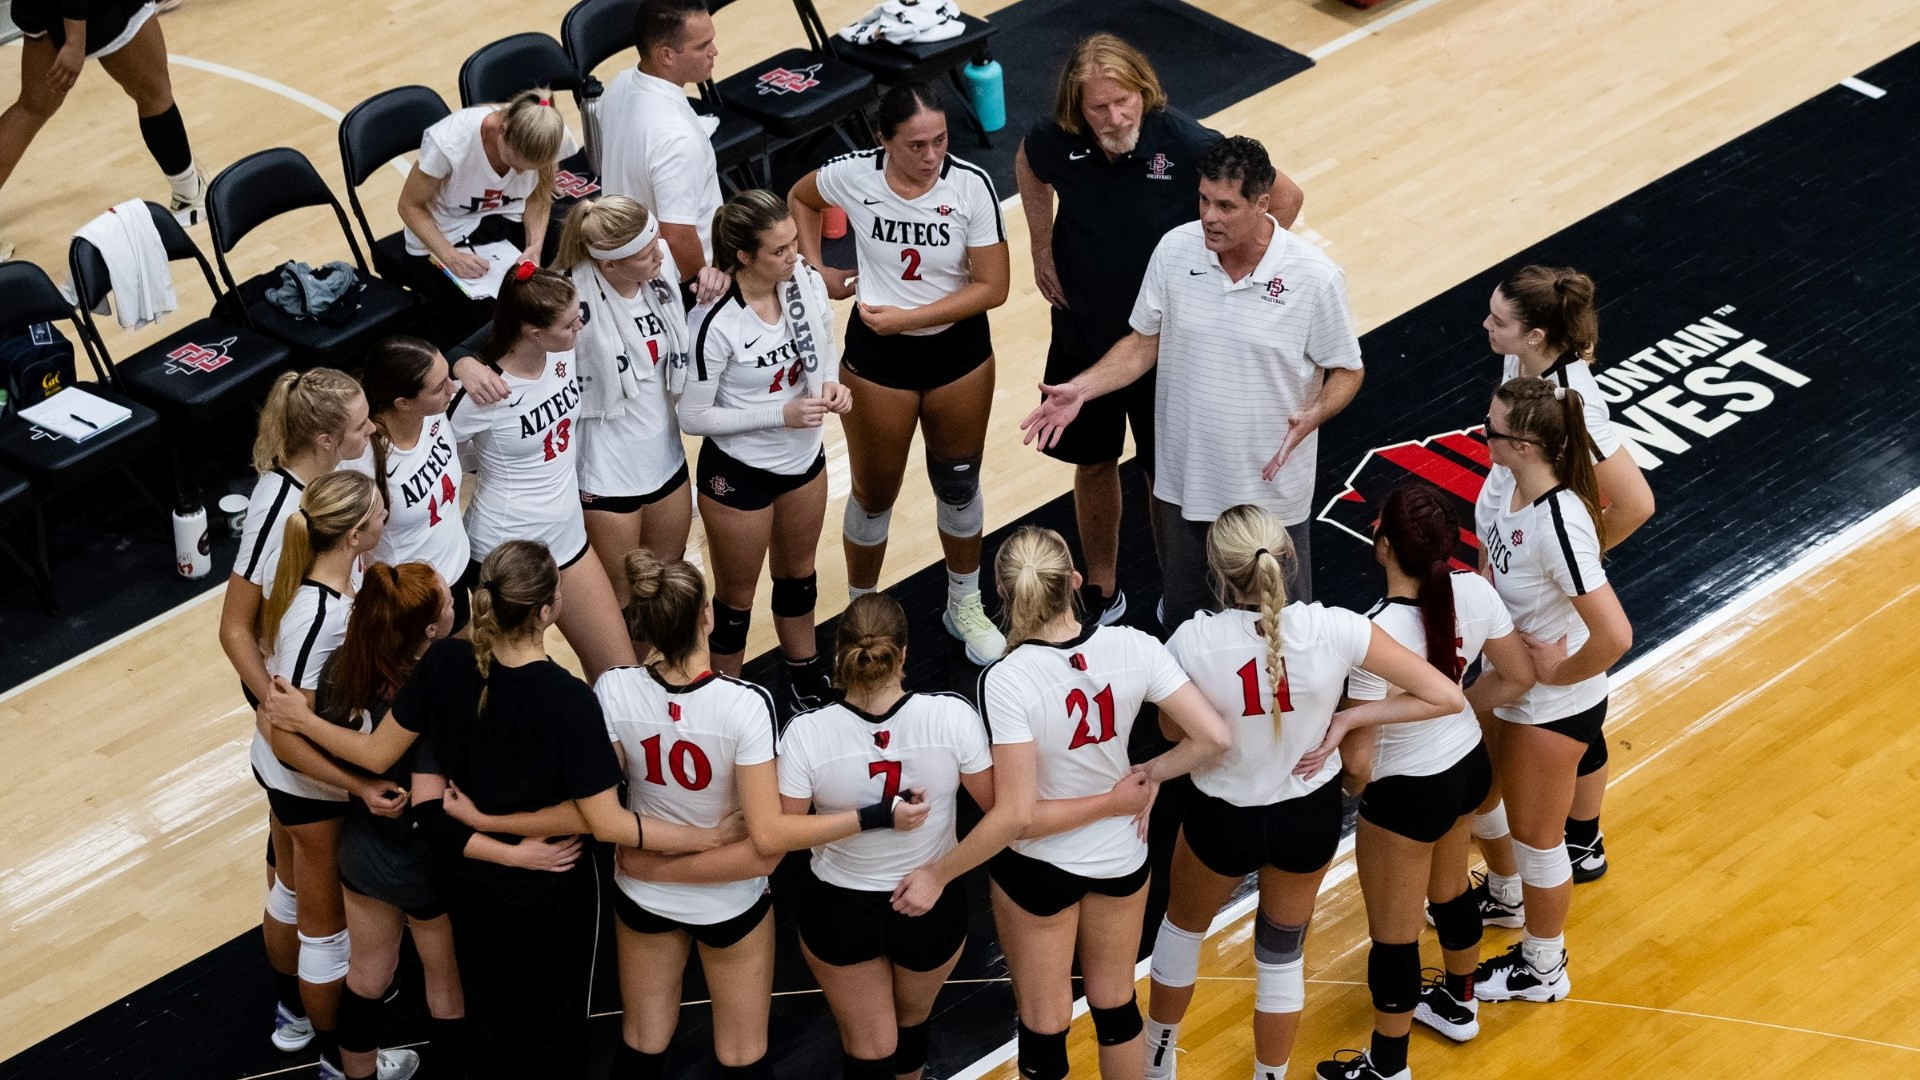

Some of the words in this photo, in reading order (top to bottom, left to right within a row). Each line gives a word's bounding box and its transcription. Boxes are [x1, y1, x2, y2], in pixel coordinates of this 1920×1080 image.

[871, 216, 951, 247] AZTECS
[901, 248, 922, 281] 2
[786, 275, 818, 373] GATOR
[42, 370, 60, 389] Cal
[1594, 316, 1744, 404] UNTAIN
[519, 379, 580, 440] AZTECS
[542, 418, 572, 462] 13
[400, 435, 452, 509] AZTECS
[427, 473, 456, 528] 14
[1065, 682, 1118, 751] 21
[640, 733, 713, 791] 10
[868, 760, 902, 803] 7
